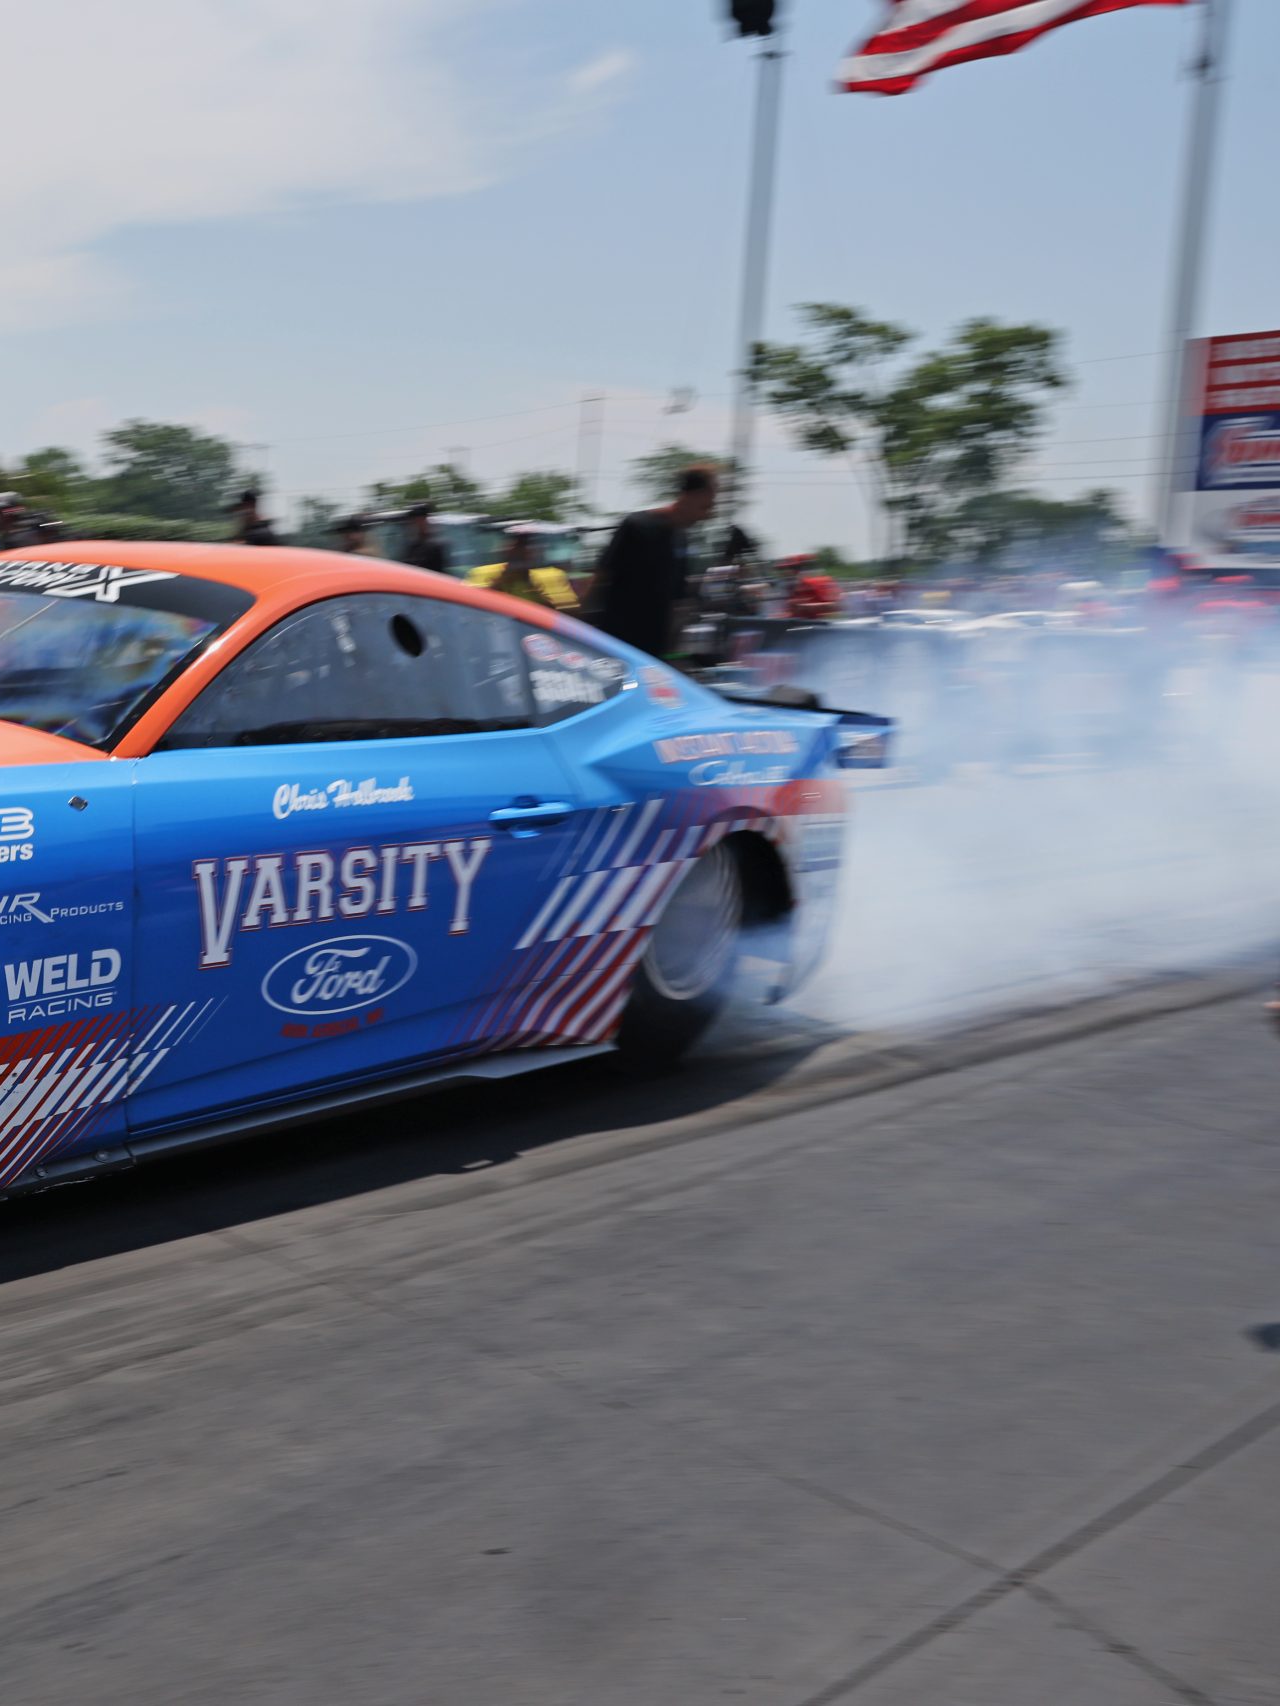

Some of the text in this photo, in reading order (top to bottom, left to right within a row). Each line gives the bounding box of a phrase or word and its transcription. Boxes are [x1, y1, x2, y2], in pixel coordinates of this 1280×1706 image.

[192, 835, 493, 970] VARSITY
[4, 948, 122, 1001] WELD
[290, 946, 392, 1004] Ford
[7, 991, 115, 1025] RACING
